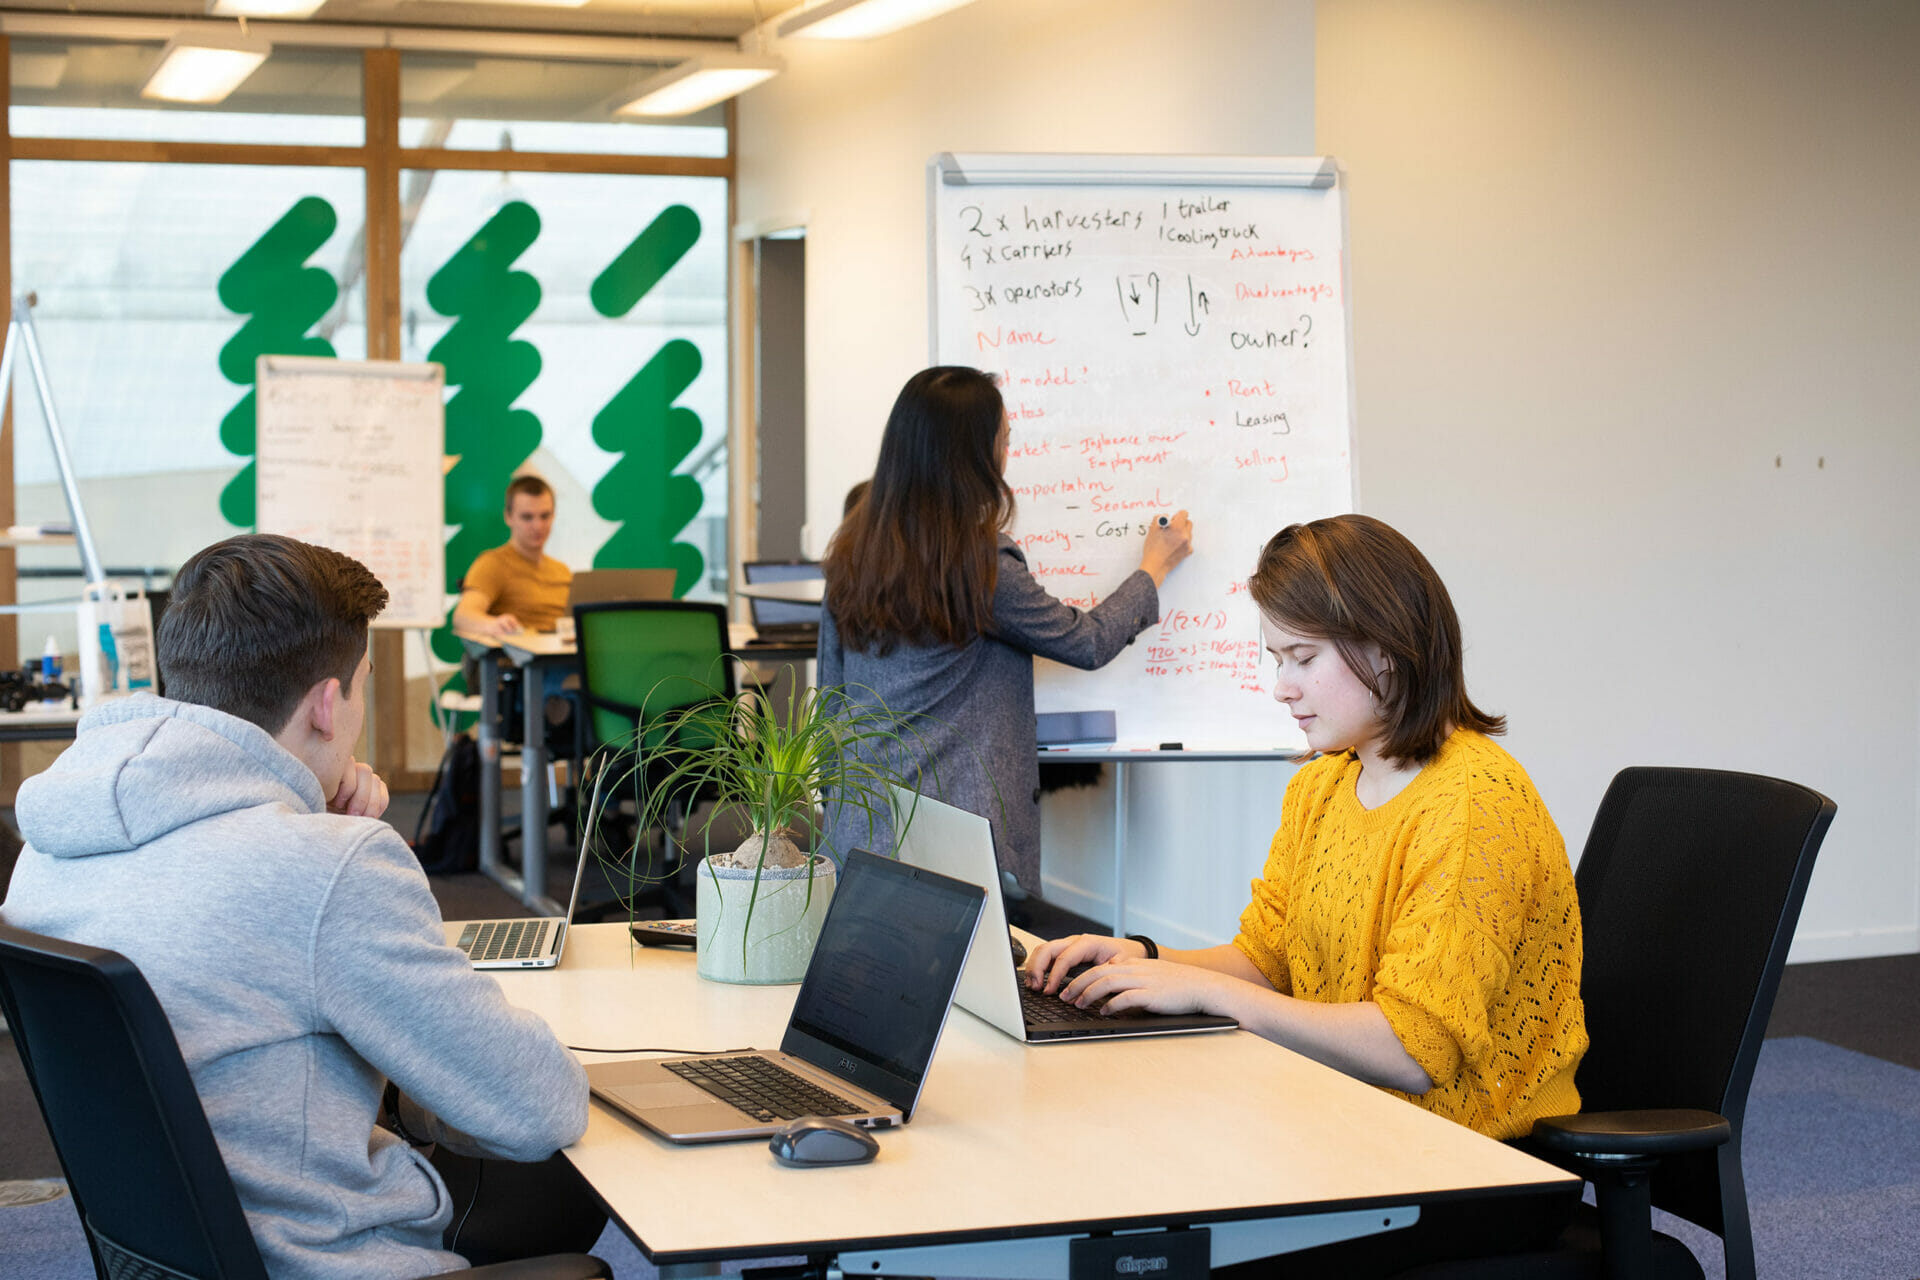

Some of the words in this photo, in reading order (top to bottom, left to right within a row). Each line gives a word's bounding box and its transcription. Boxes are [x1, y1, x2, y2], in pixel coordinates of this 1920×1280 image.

[1178, 196, 1230, 218] trailer
[960, 206, 992, 237] 2
[1024, 205, 1143, 232] harvesters
[976, 325, 1056, 352] Name
[1228, 379, 1277, 397] Rent
[1235, 411, 1290, 435] Leasing
[1088, 451, 1172, 472] Employment
[1014, 530, 1072, 552] apacity
[1096, 520, 1129, 538] Cost
